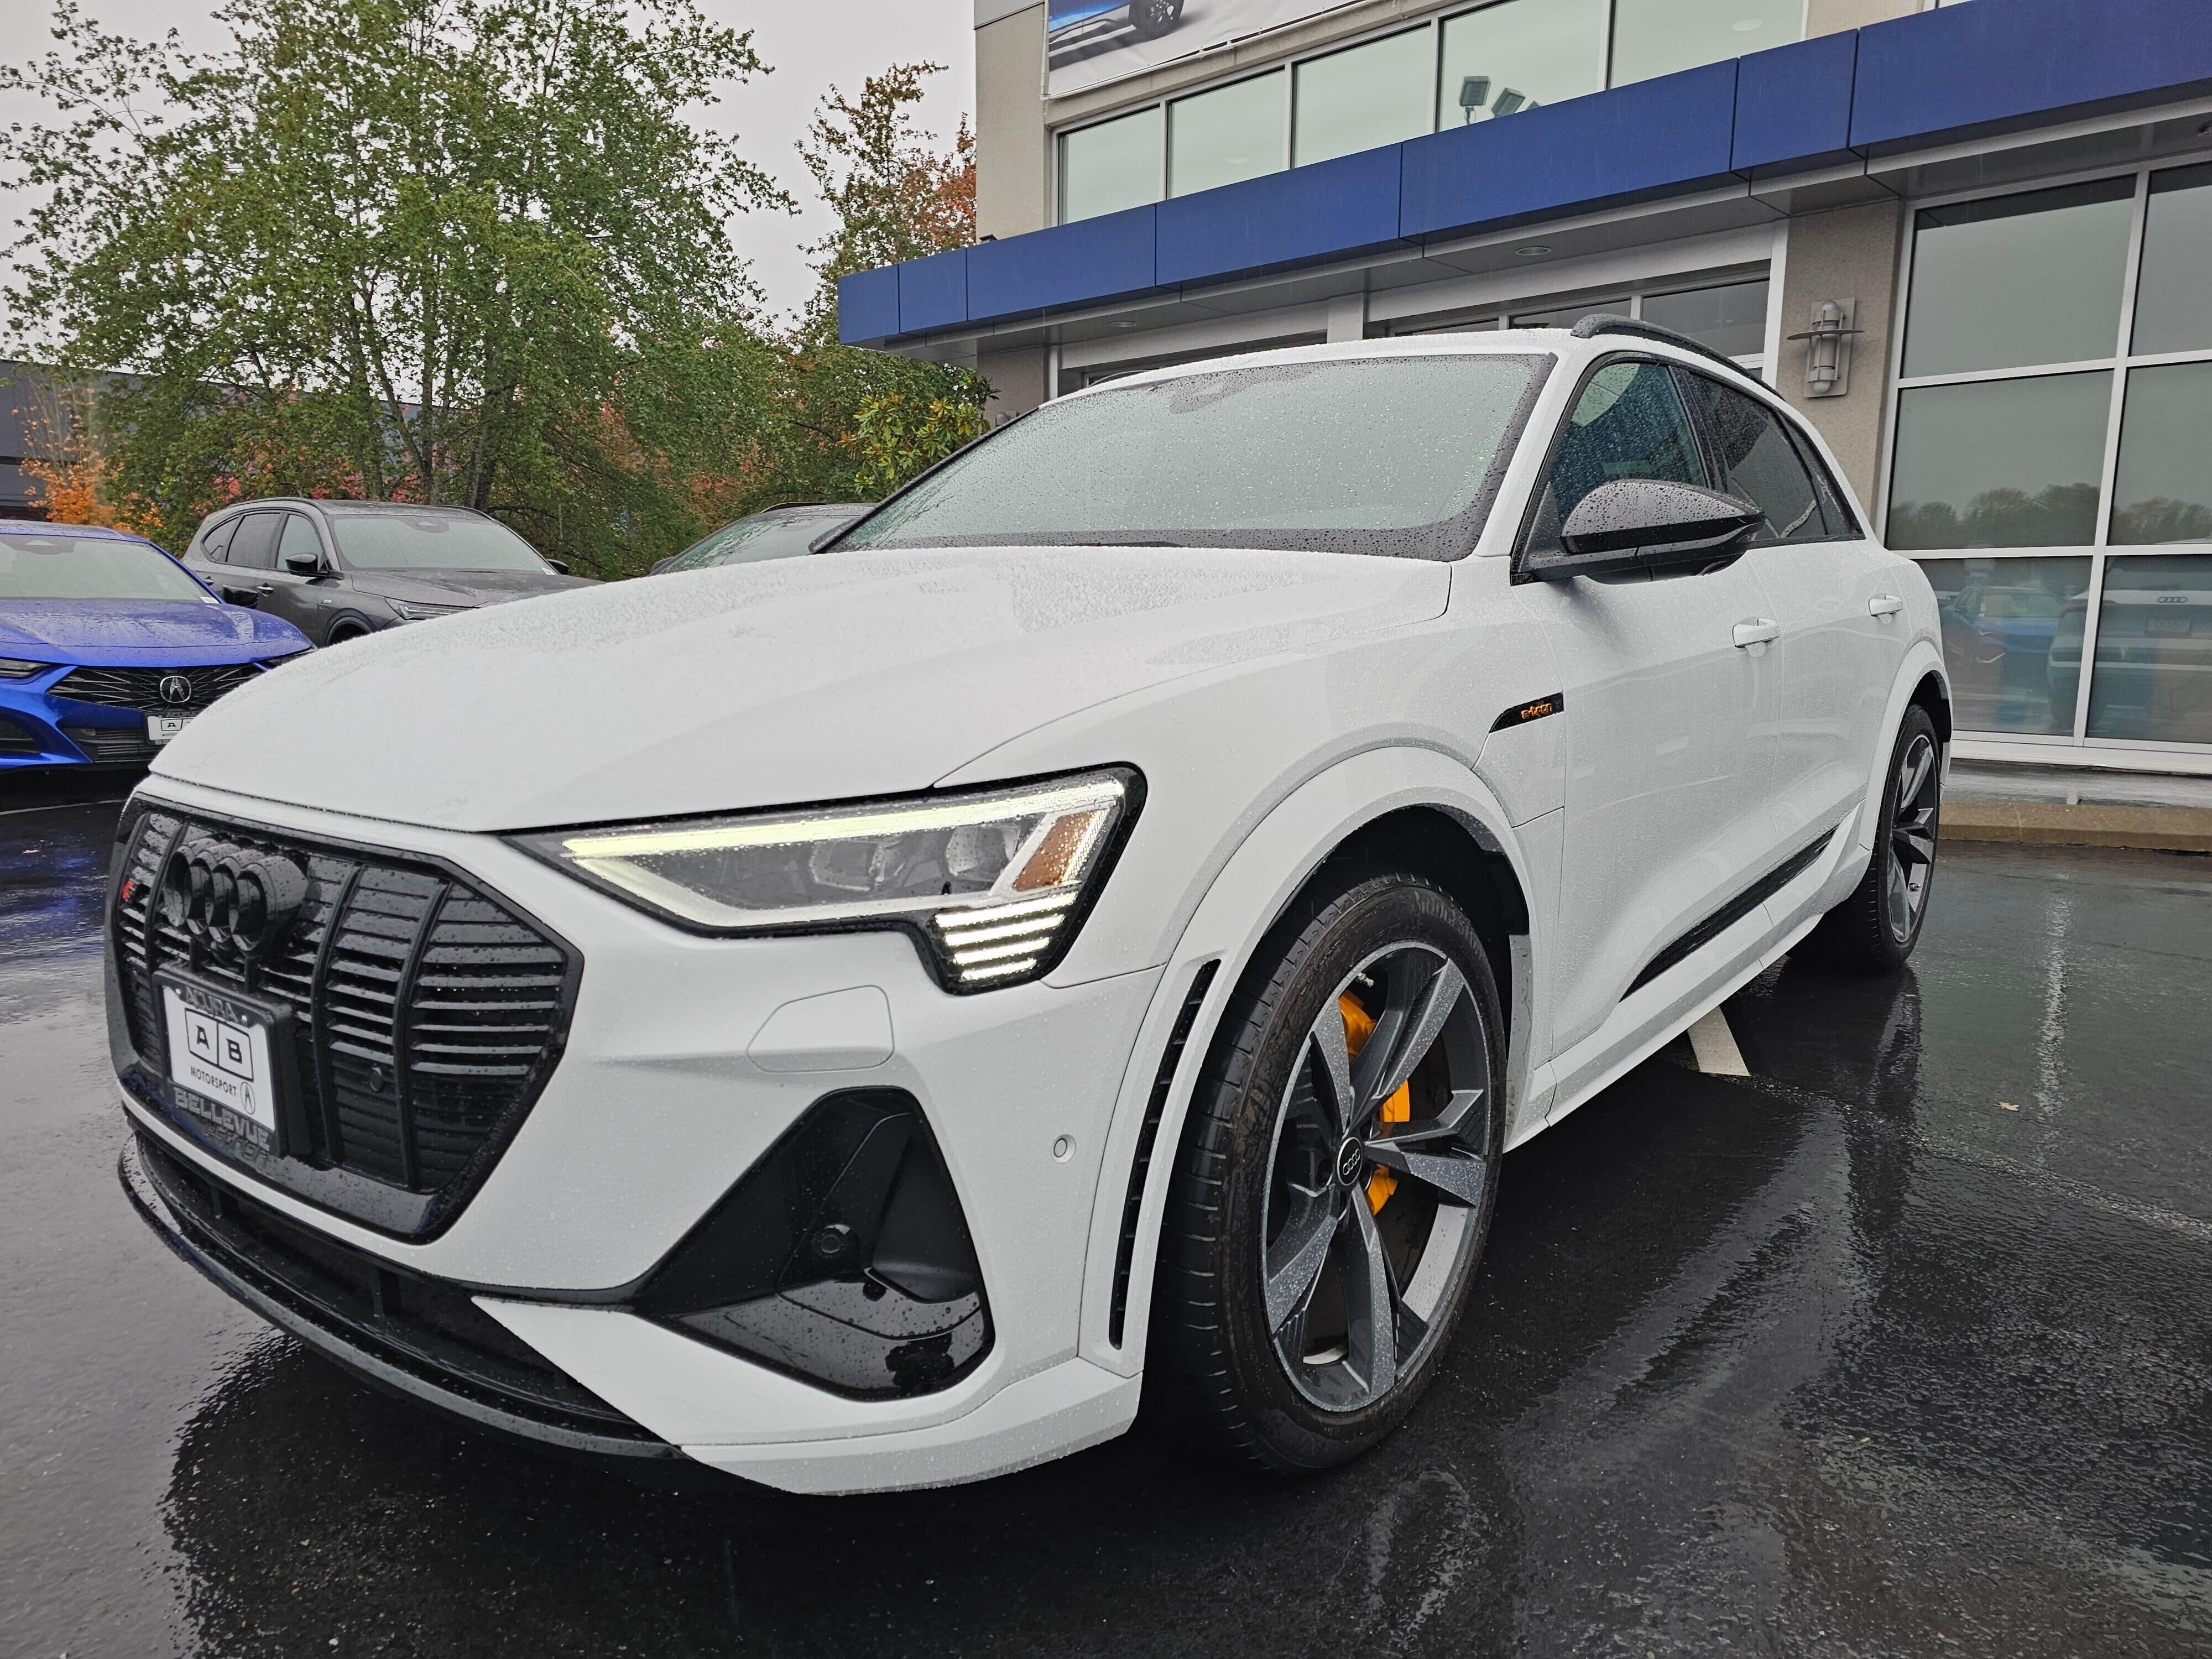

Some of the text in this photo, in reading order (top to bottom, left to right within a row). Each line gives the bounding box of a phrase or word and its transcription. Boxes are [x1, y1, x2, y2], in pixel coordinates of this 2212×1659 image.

[186, 986, 239, 1023] ACURA
[196, 1025, 243, 1064] A B
[190, 1066, 237, 1098] MOTORSPORT
[173, 1087, 270, 1151] BELLEVUE
